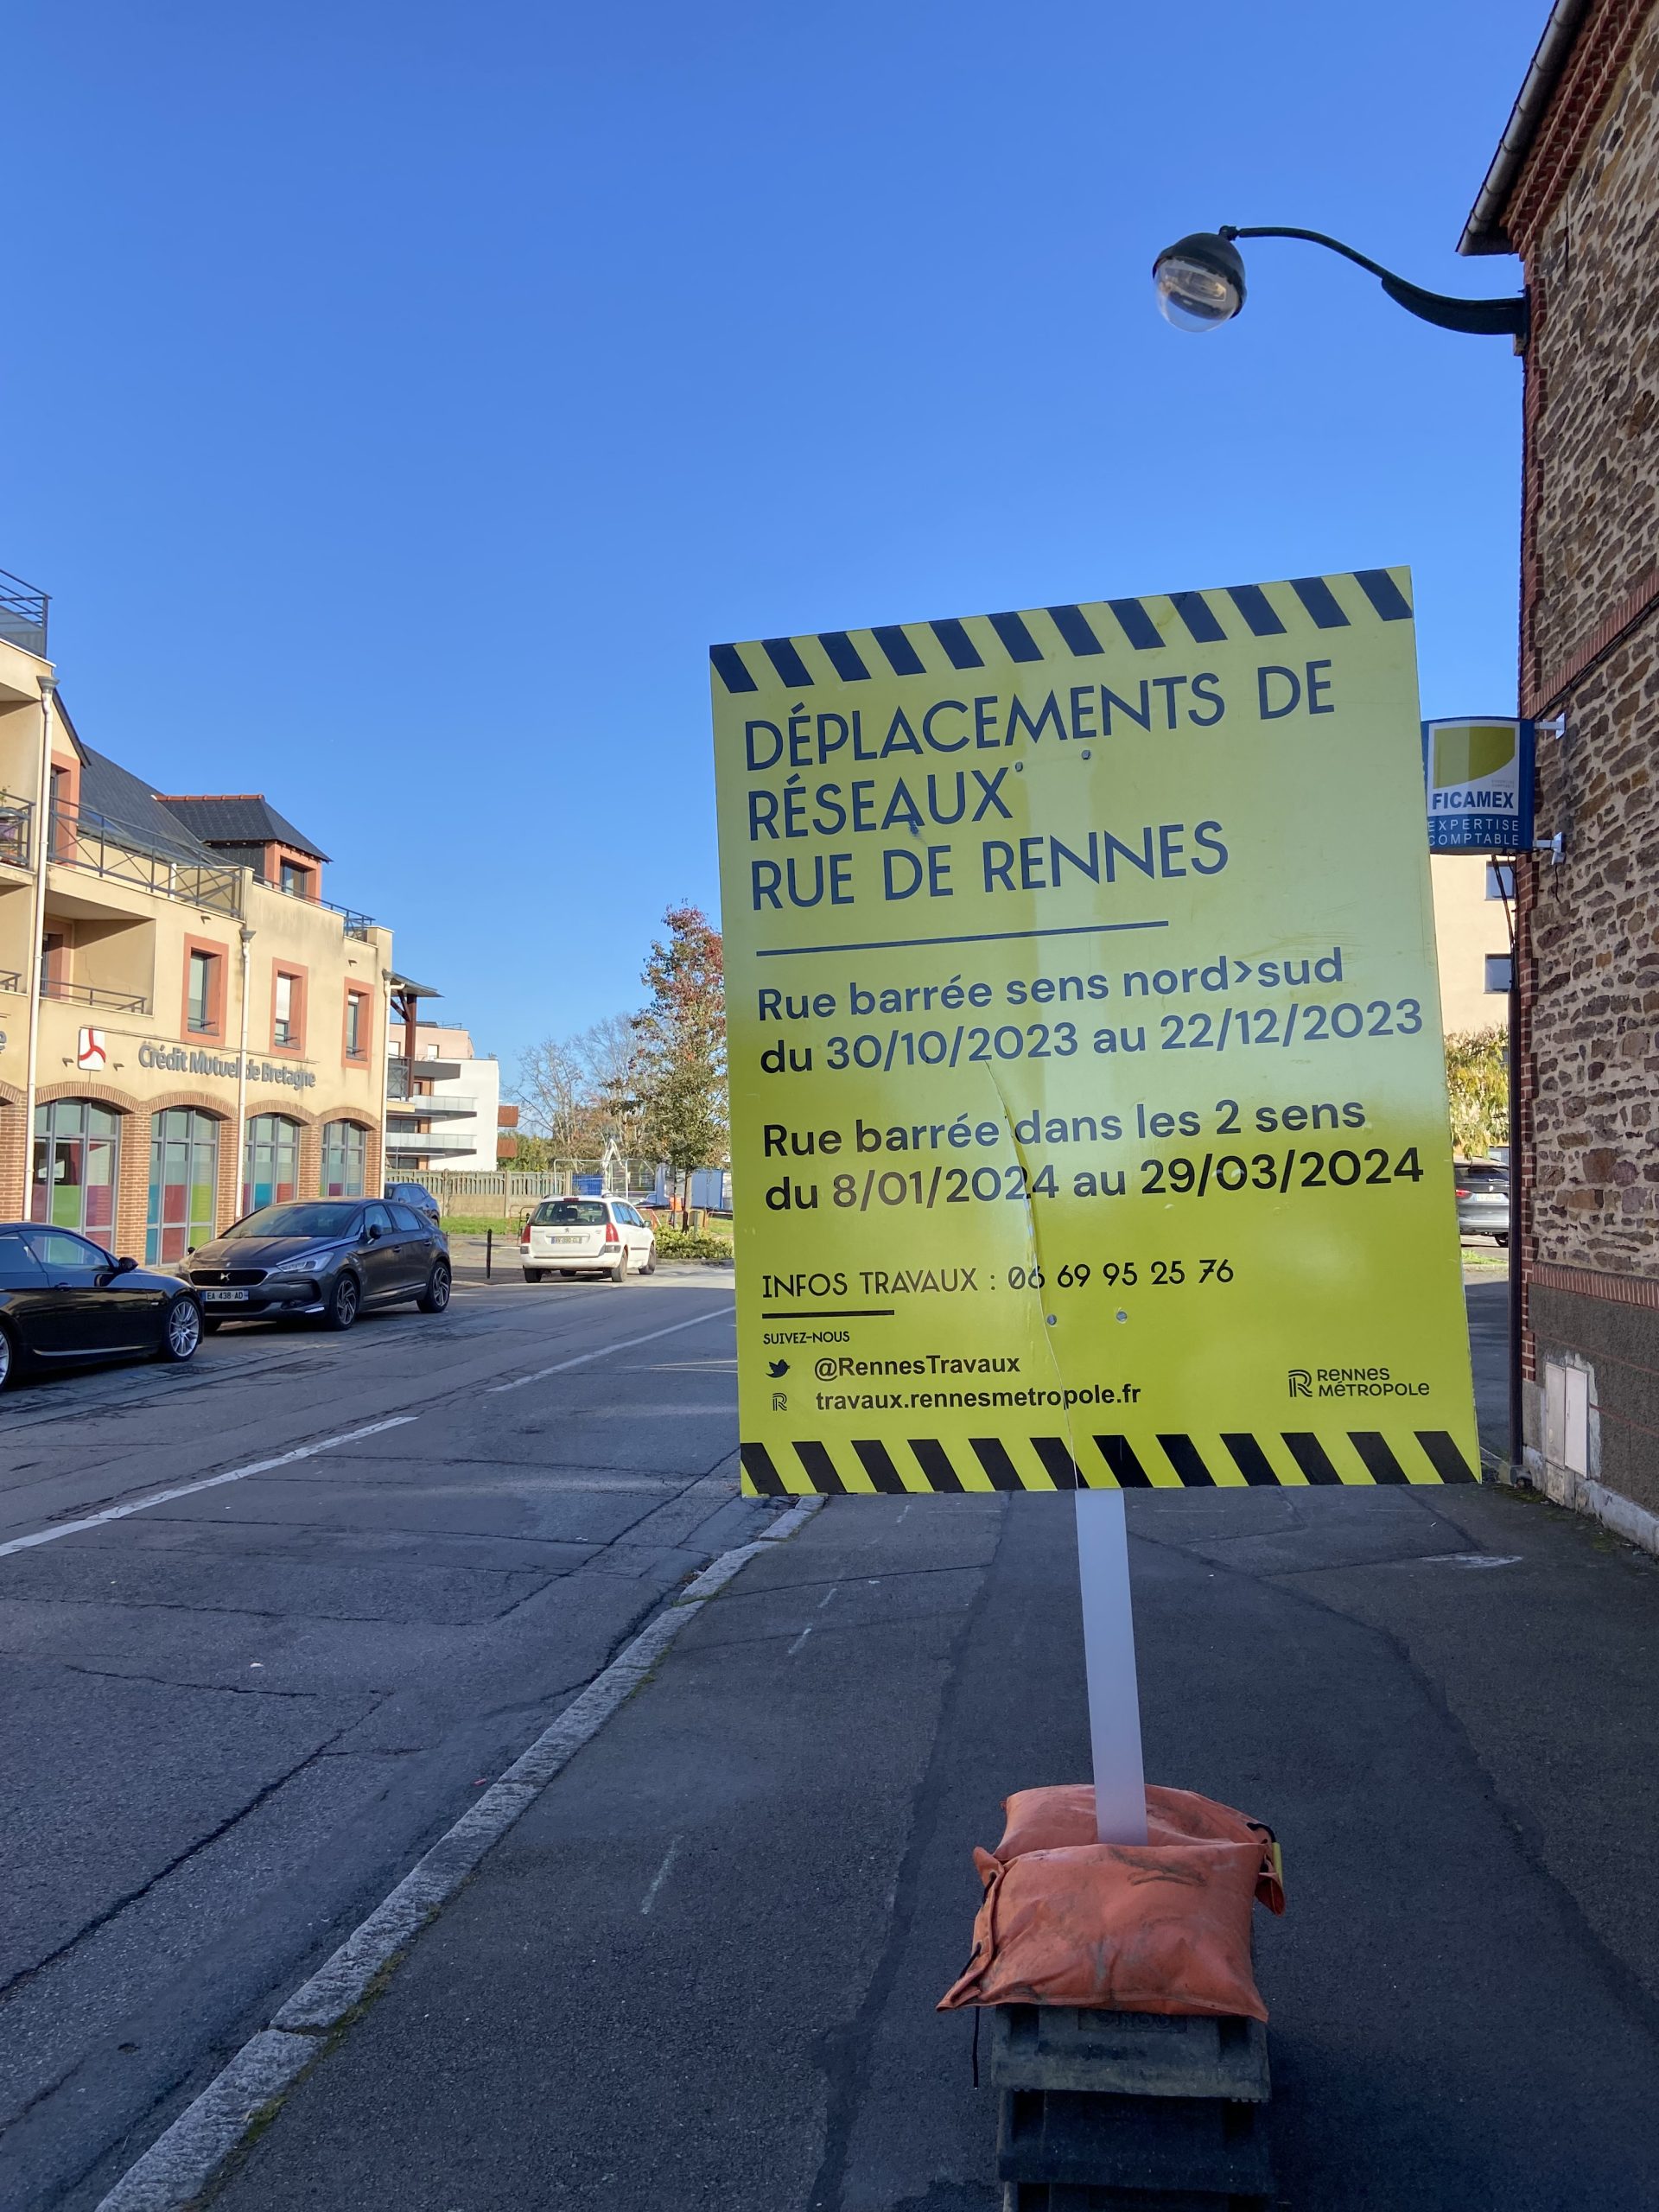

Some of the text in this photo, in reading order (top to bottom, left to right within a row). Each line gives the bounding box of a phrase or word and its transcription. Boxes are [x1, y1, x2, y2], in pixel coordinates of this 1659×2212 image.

[745, 659, 1335, 772] DÉPLACEMENTS DE
[748, 767, 1013, 842] RÉSEAUX
[1432, 791, 1515, 810] FICAMEX
[1427, 819, 1519, 832] EXPERTISE
[1427, 833, 1519, 846] COMPTABLE
[752, 820, 1229, 911] RUE DE RENNES
[758, 988, 836, 1021] Rue
[850, 975, 993, 1016] barrée
[1007, 975, 1109, 1005] sens
[760, 997, 1422, 1074] du 30/10/2023 au 22/12/2023
[138, 1044, 188, 1072] Crédit
[189, 1050, 241, 1079] Mutuel
[262, 1062, 316, 1090] Bretagne
[764, 1100, 1366, 1158] Rue barrée dans les 2 sens
[766, 1147, 1424, 1211] du 8/01/2024 au 29/03/2024
[762, 1274, 849, 1299] INFOS
[859, 1268, 979, 1294] TRAVAUX
[1007, 1264, 1046, 1290] 06
[1057, 1263, 1091, 1288] 69
[1103, 1262, 1138, 1287] 95
[1151, 1261, 1185, 1286] 25
[1198, 1258, 1235, 1284] 76
[762, 1331, 850, 1345] SUIVEZ-NOUS
[814, 1354, 1021, 1382] @RennesTravaux
[815, 1384, 1141, 1411] travaux.rennesmetropole.fr
